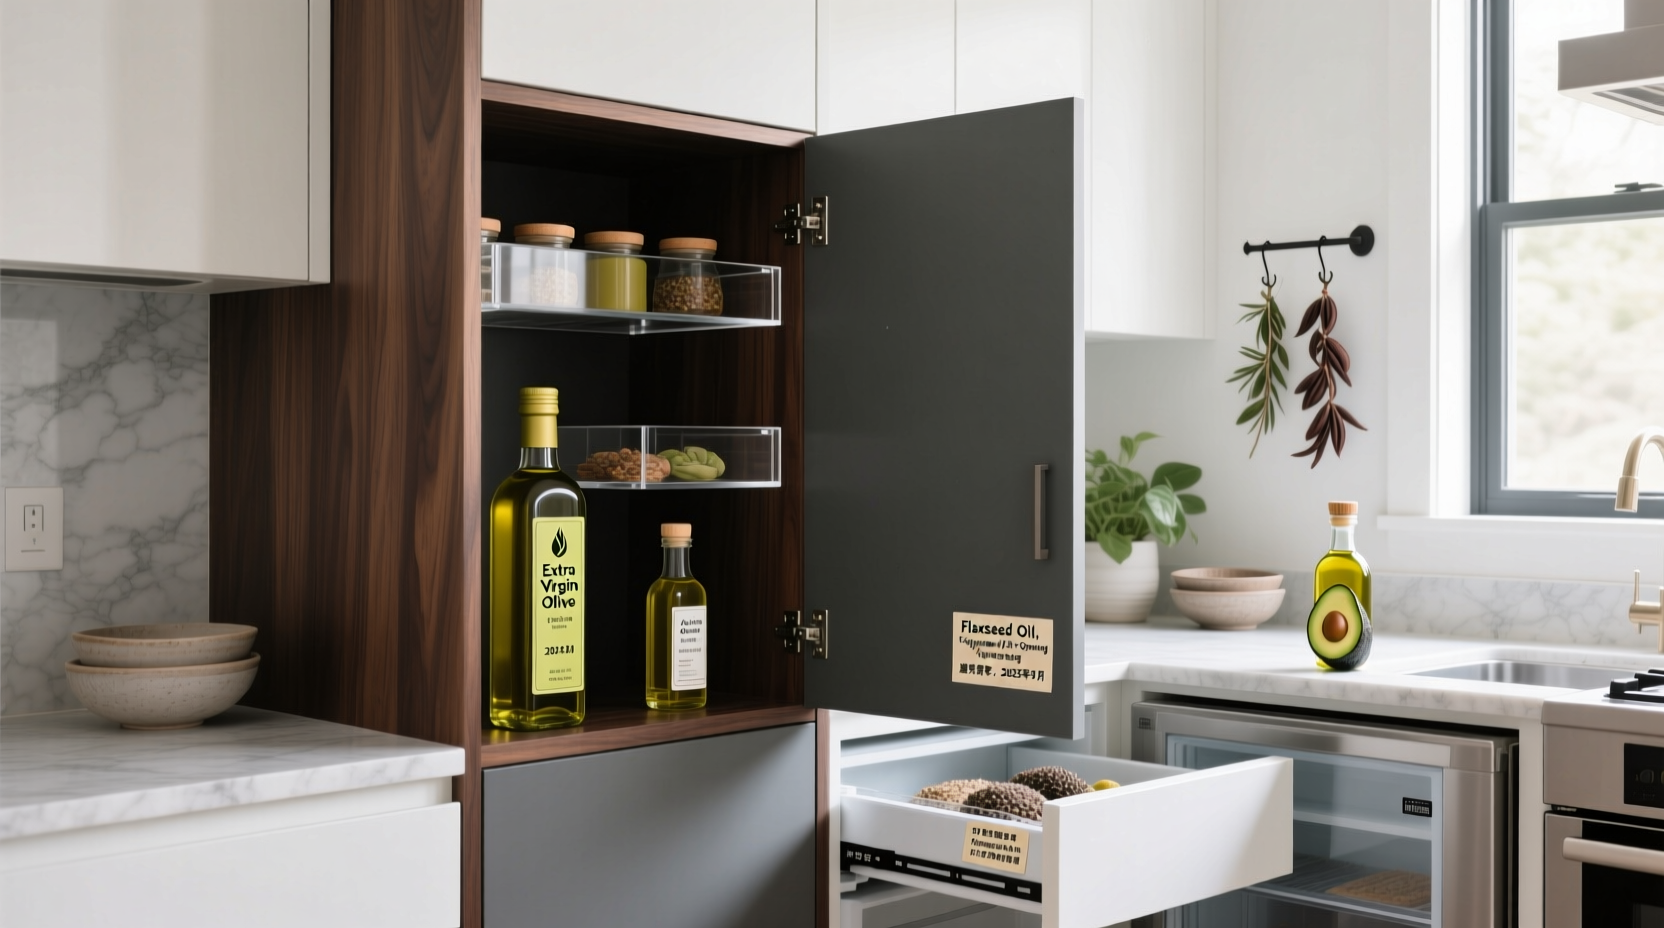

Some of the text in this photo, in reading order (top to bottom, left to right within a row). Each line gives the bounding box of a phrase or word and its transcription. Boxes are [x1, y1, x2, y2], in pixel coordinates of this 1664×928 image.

[543, 564, 576, 577] Extra
[540, 578, 579, 596] Virgin
[961, 620, 1013, 636] Flaxseed
